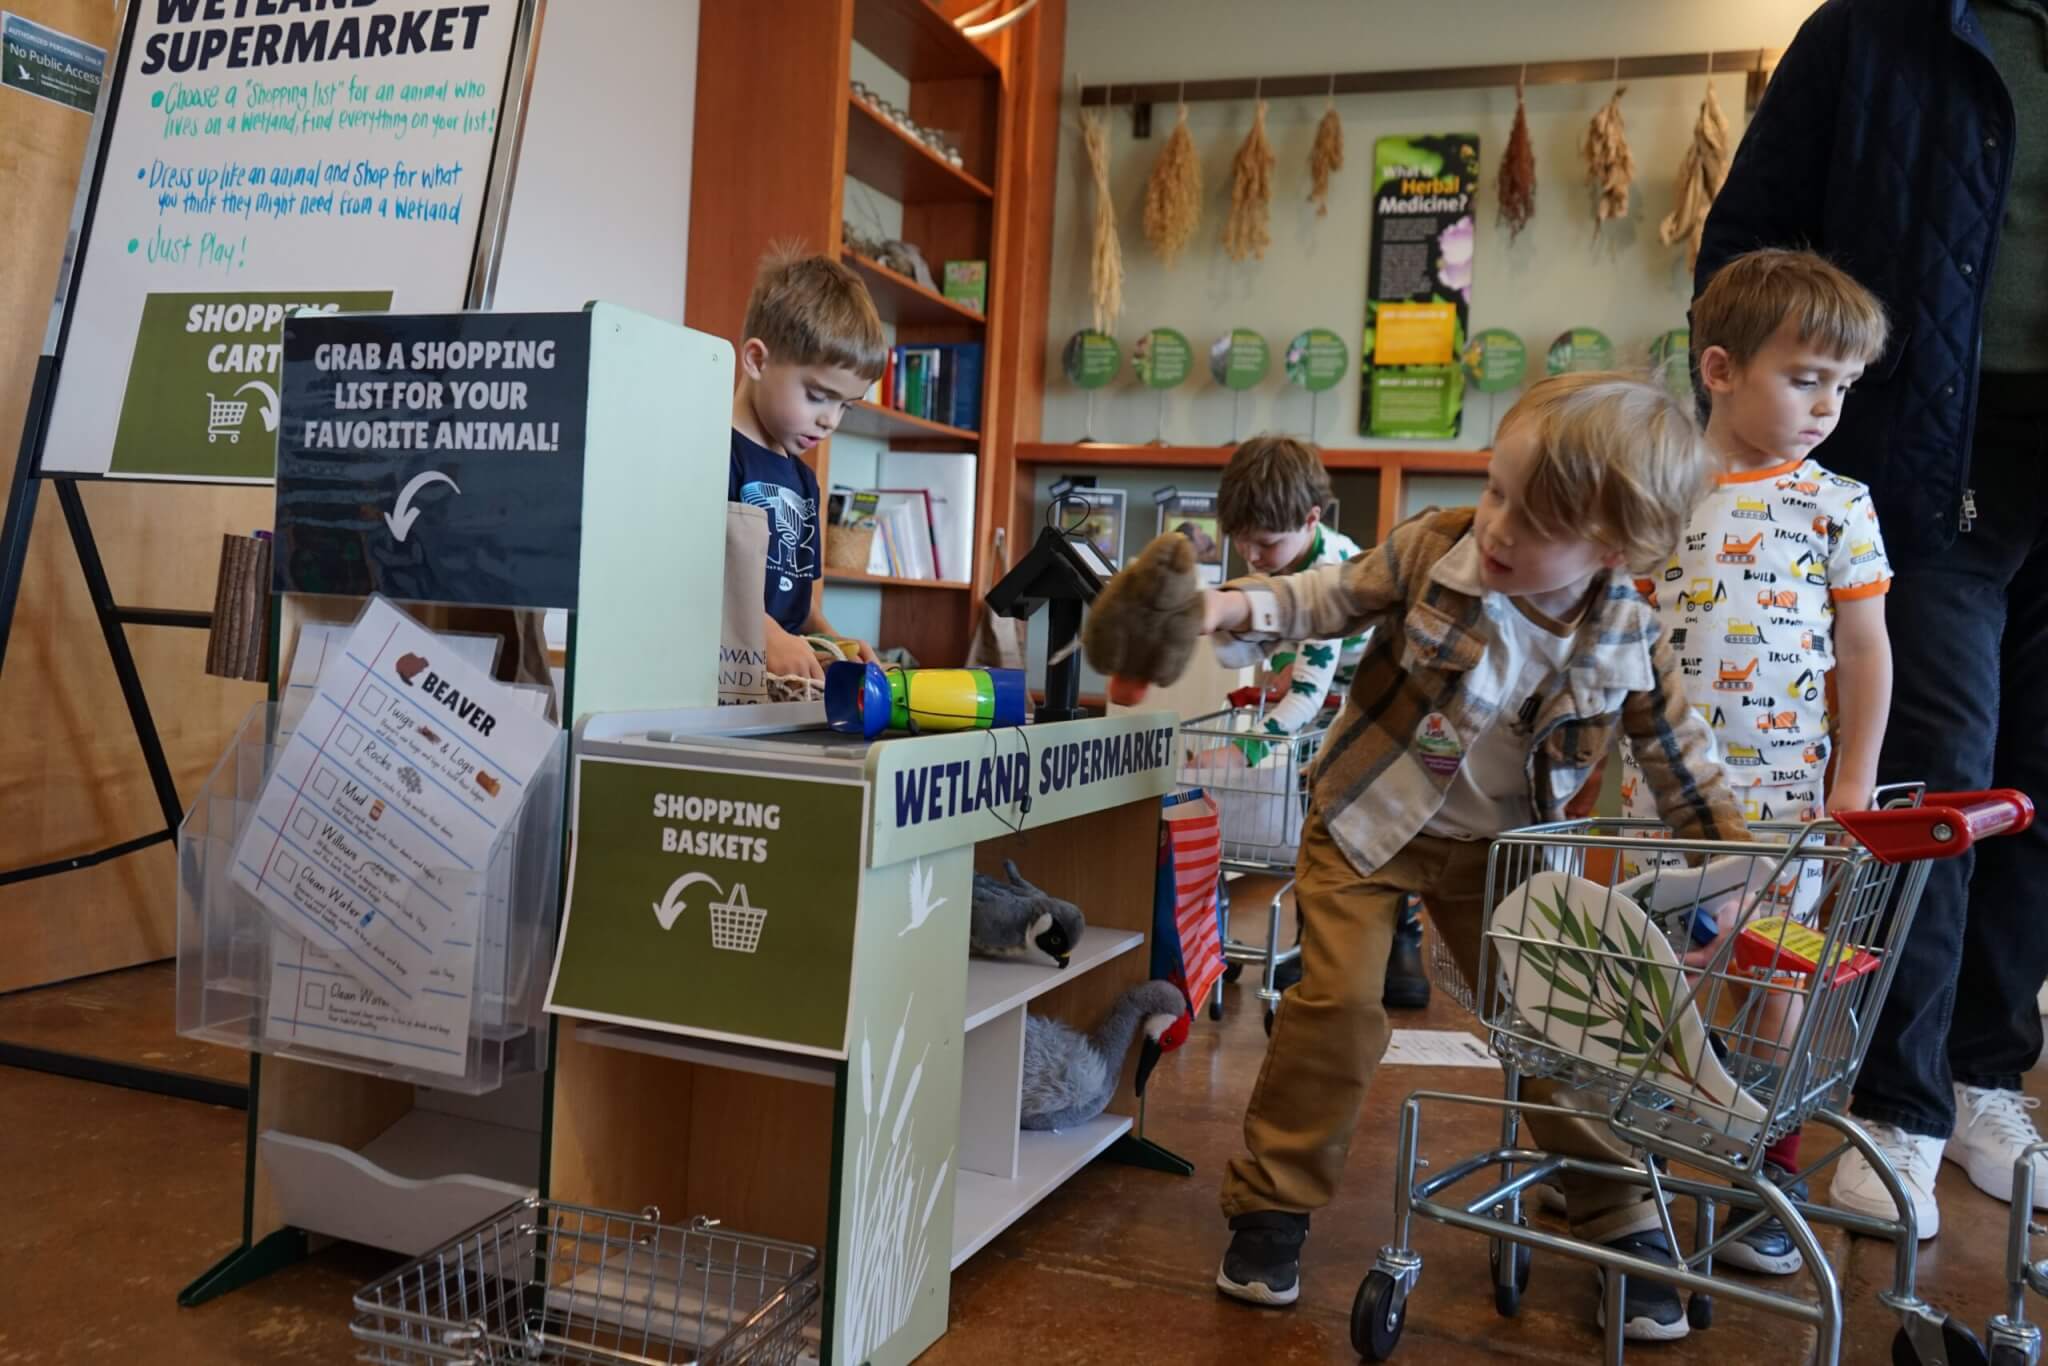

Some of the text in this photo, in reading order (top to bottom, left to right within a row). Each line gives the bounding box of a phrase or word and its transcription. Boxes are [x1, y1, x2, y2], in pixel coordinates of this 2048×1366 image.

[141, 5, 489, 75] SUPERMARKET
[10, 42, 26, 58] No
[30, 50, 62, 72] Public
[65, 63, 100, 86] Access
[165, 81, 219, 114] Choose
[225, 86, 238, 107] a
[349, 74, 370, 104] for
[375, 83, 395, 101] an
[401, 80, 449, 103] animal
[455, 80, 485, 99] who
[164, 114, 198, 139] lives
[204, 117, 222, 135] on
[227, 116, 236, 133] a
[339, 108, 408, 140] everything
[411, 111, 429, 129] on
[432, 111, 459, 138] your
[464, 108, 496, 135] list!
[149, 158, 193, 189] Dress
[198, 167, 219, 198] up
[220, 160, 246, 190] like
[248, 167, 266, 186] an
[270, 160, 322, 188] animal
[324, 160, 350, 185] and
[394, 161, 417, 188] for
[422, 161, 463, 189] what
[1402, 175, 1460, 195] Herbal
[159, 192, 178, 216] you
[183, 191, 216, 214] think
[221, 191, 251, 220] they
[300, 190, 334, 216] need
[340, 190, 373, 216] from
[378, 197, 388, 219] a
[1379, 192, 1467, 214] Medicine?
[148, 224, 247, 275] Just Play!
[185, 303, 340, 333] SHOPP
[208, 344, 282, 373] CART
[315, 340, 556, 371] GRAB A SHOPPING
[335, 381, 528, 410] LIST FOR YOUR
[304, 421, 560, 451] FAVORITE ANIMAL!
[1782, 496, 1817, 510] VROOM
[1774, 528, 1809, 544] TRUCK
[1744, 569, 1777, 583] BUILD
[1768, 651, 1802, 664] TRUCK
[718, 671, 753, 688] ND
[421, 672, 497, 737] BEAVER
[1742, 696, 1776, 708] BUILD
[386, 698, 476, 777] Twigs & Logs
[363, 741, 392, 771] Rocks
[895, 727, 1174, 829] WETLAND SUPERMARKET
[1771, 769, 1808, 782] TRUCK
[342, 781, 368, 806] Mud
[1786, 790, 1814, 801] BUILD
[653, 792, 780, 830] SHOPPING
[321, 823, 358, 861] Willows
[662, 827, 768, 863] BASKETS
[301, 866, 361, 918] Clean Water
[330, 982, 356, 1001] Clean
